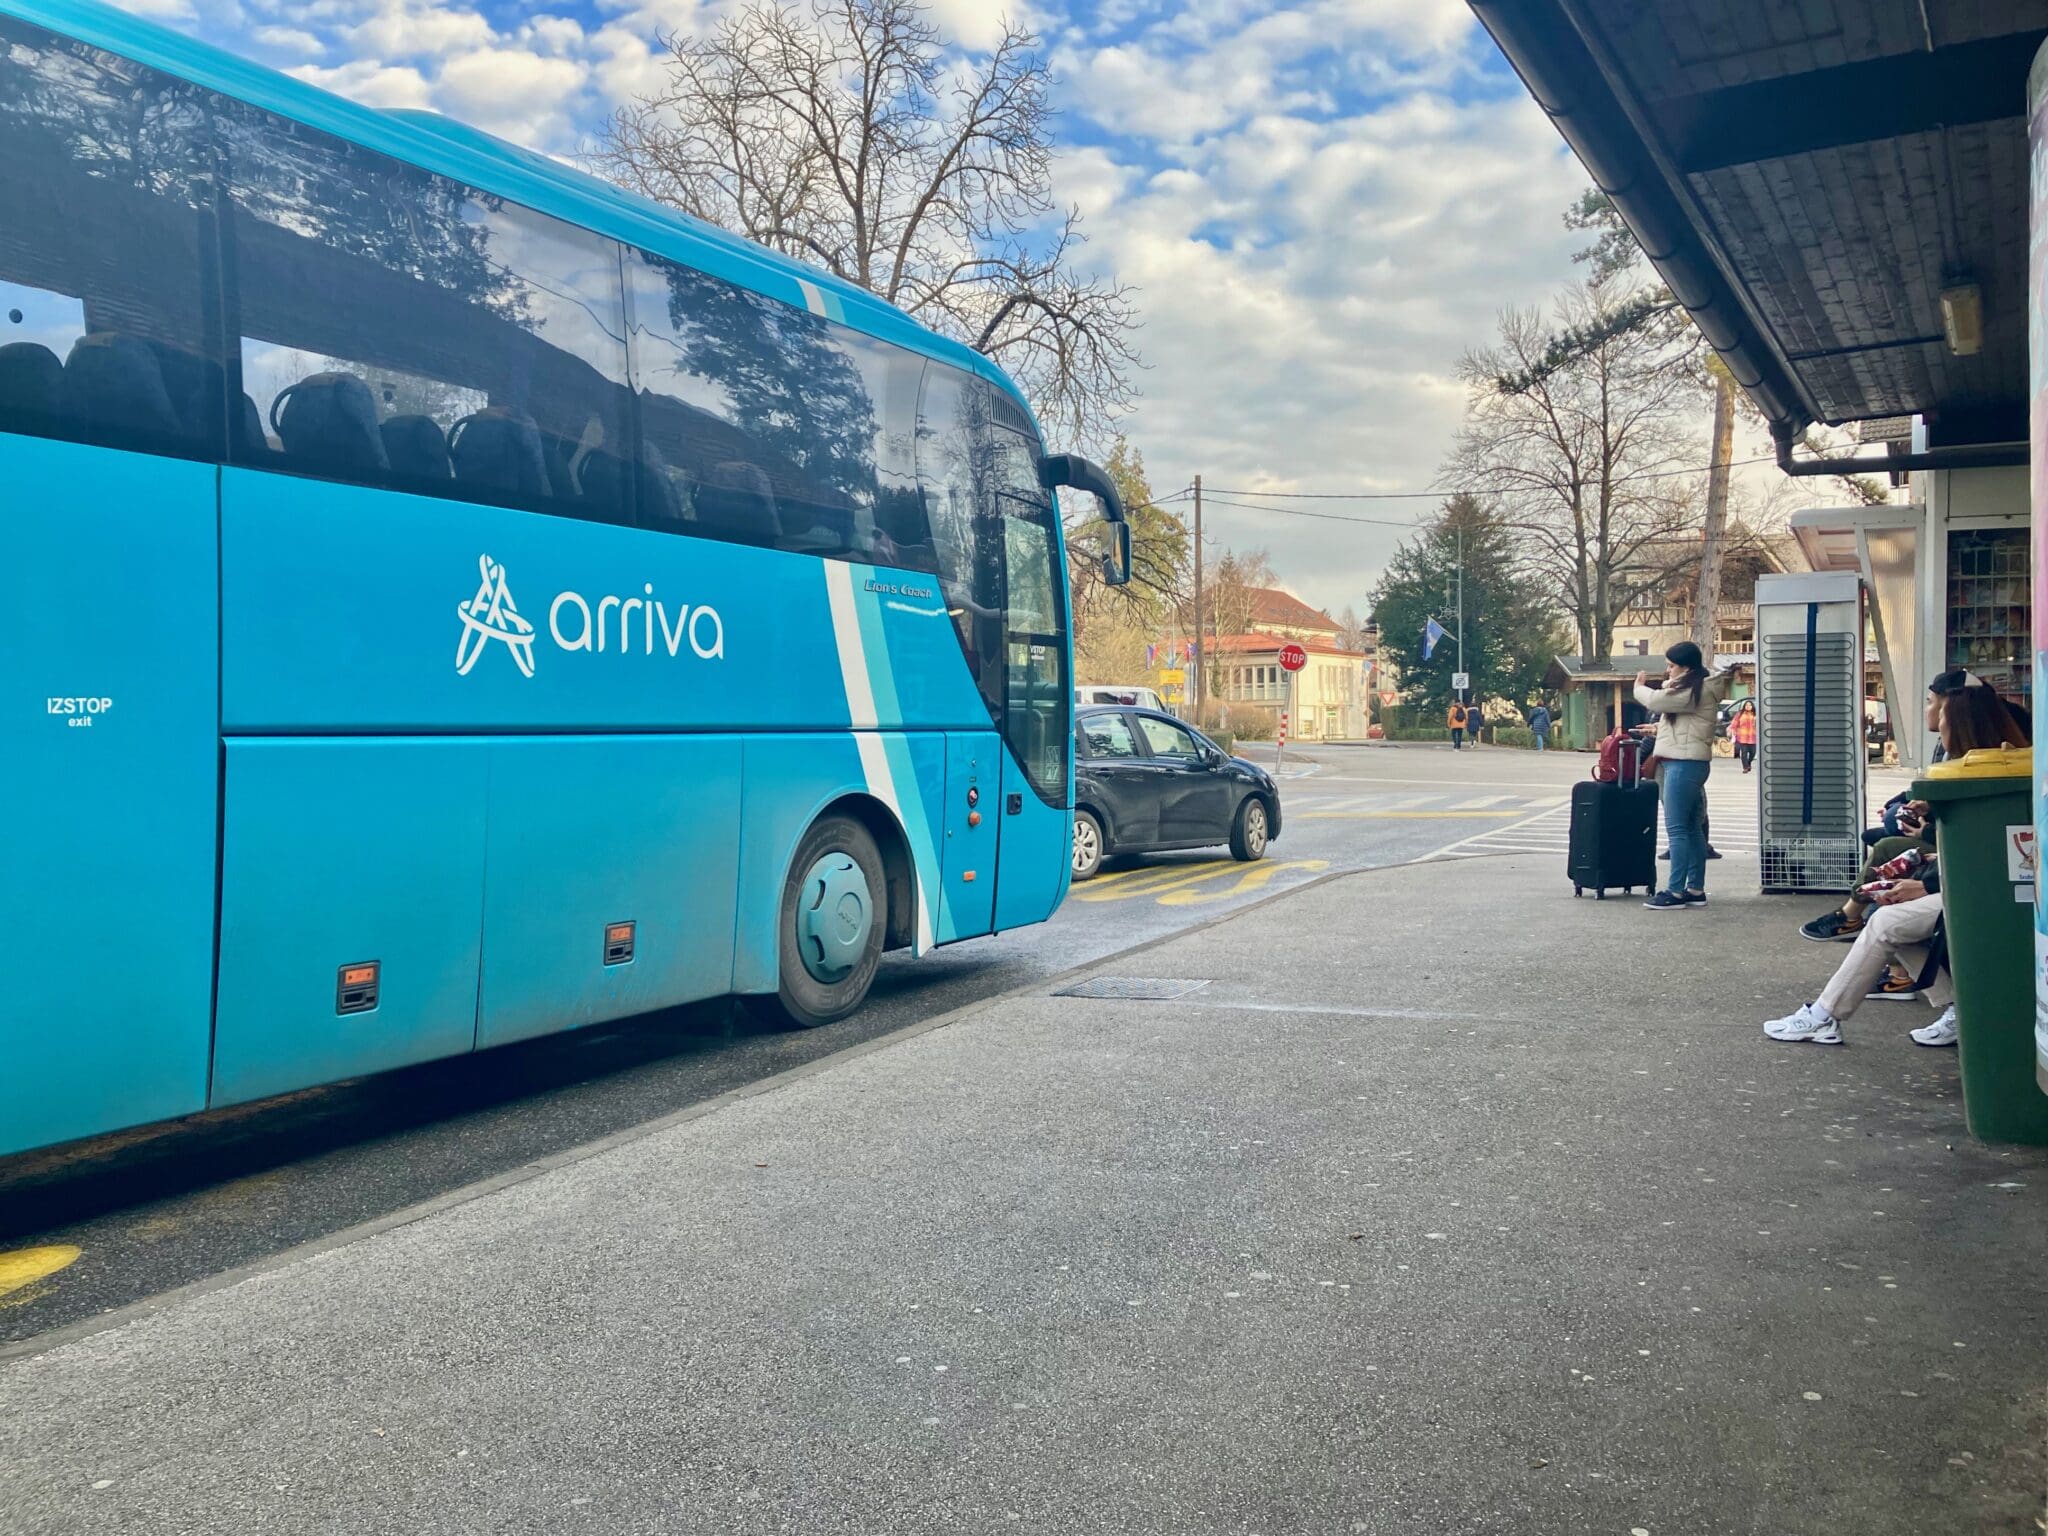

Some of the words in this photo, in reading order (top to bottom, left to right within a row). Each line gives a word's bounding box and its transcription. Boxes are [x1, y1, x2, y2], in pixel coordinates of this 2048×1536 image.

[865, 578, 897, 594] Lion's
[900, 584, 932, 599] Coach
[549, 582, 724, 660] arriva
[1280, 651, 1305, 665] STOP
[47, 697, 113, 714] IZSTOP
[68, 715, 92, 727] exit
